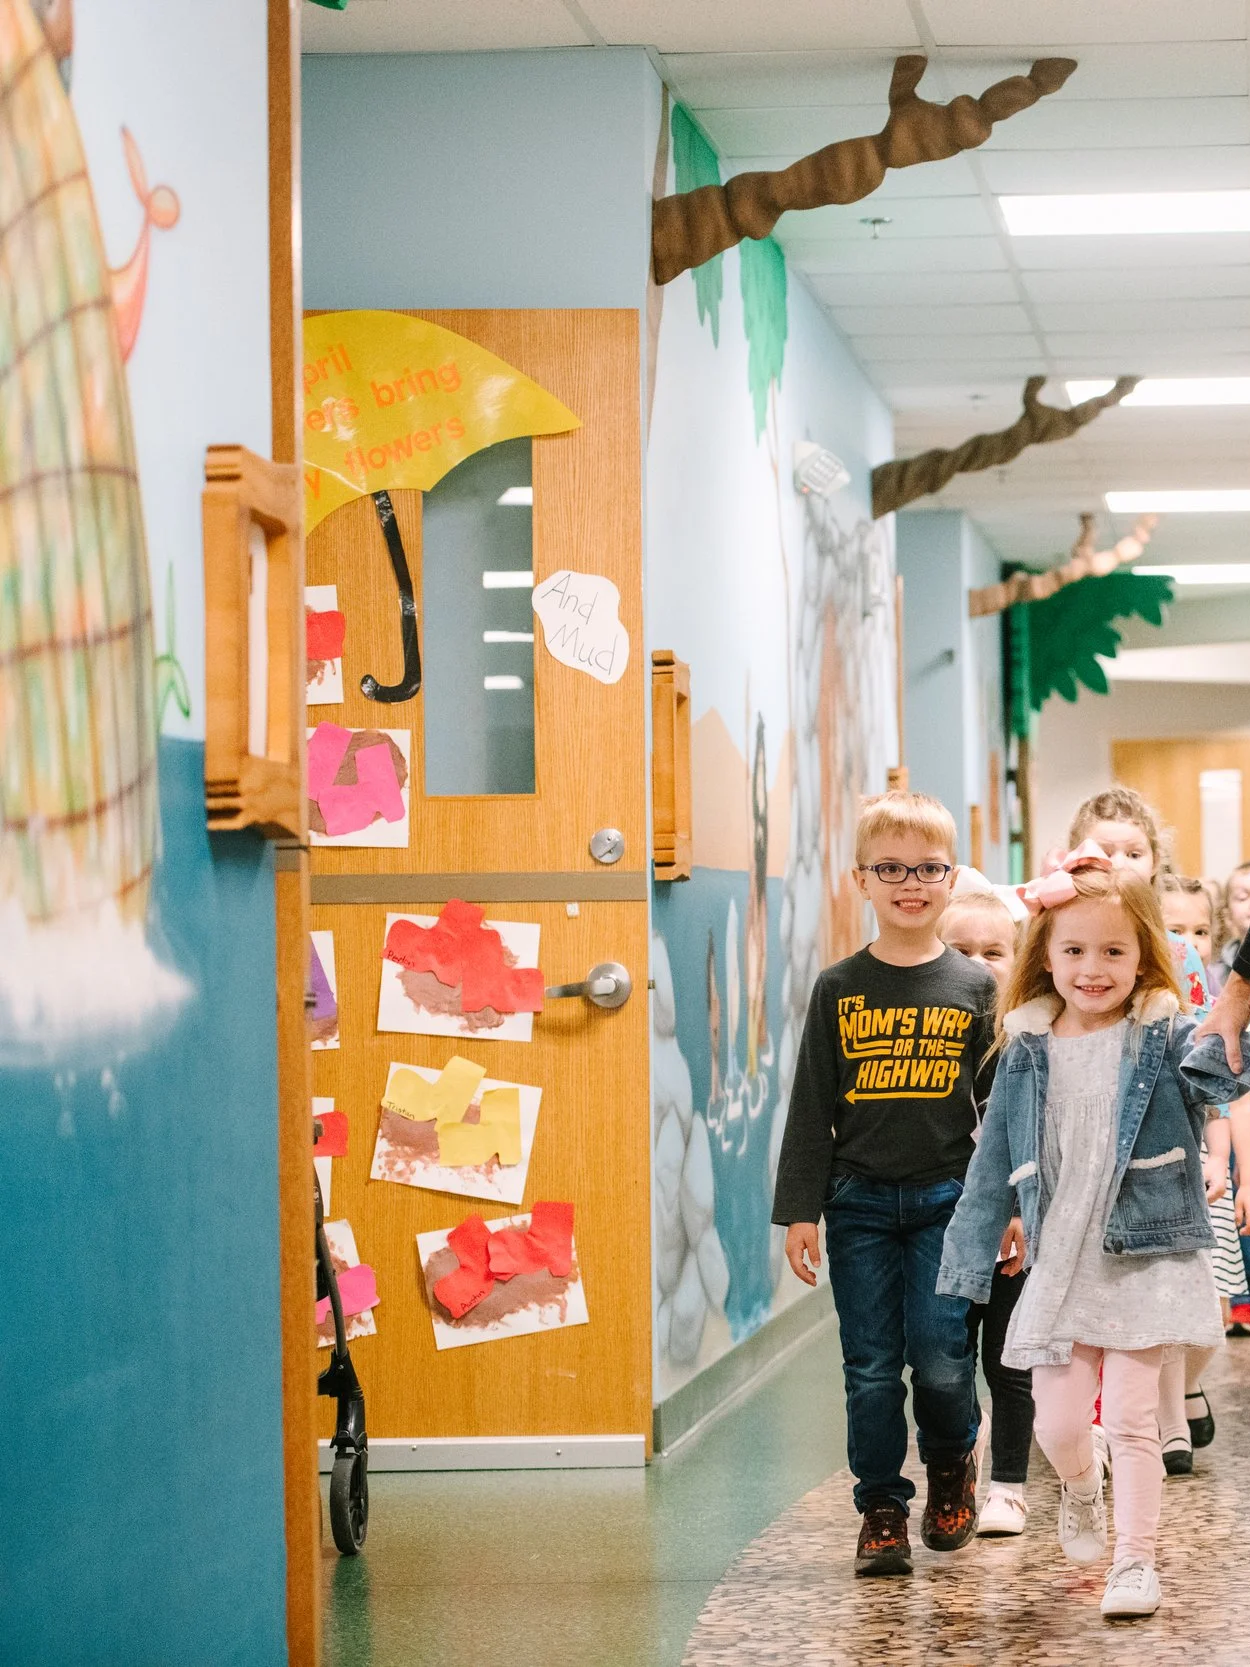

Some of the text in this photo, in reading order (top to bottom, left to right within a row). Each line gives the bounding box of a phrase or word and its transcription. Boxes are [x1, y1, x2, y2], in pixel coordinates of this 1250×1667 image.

[303, 342, 353, 394] pril
[370, 360, 462, 410] bring
[343, 415, 466, 478] flowers
[541, 573, 599, 626] And
[548, 623, 619, 676] Mud
[838, 995, 866, 1015] IT'S
[838, 1007, 973, 1040] MOM'S WAY
[893, 1038, 946, 1057] OR THE
[855, 1059, 961, 1089] HIGHWAY
[387, 1101, 415, 1120] Tristan
